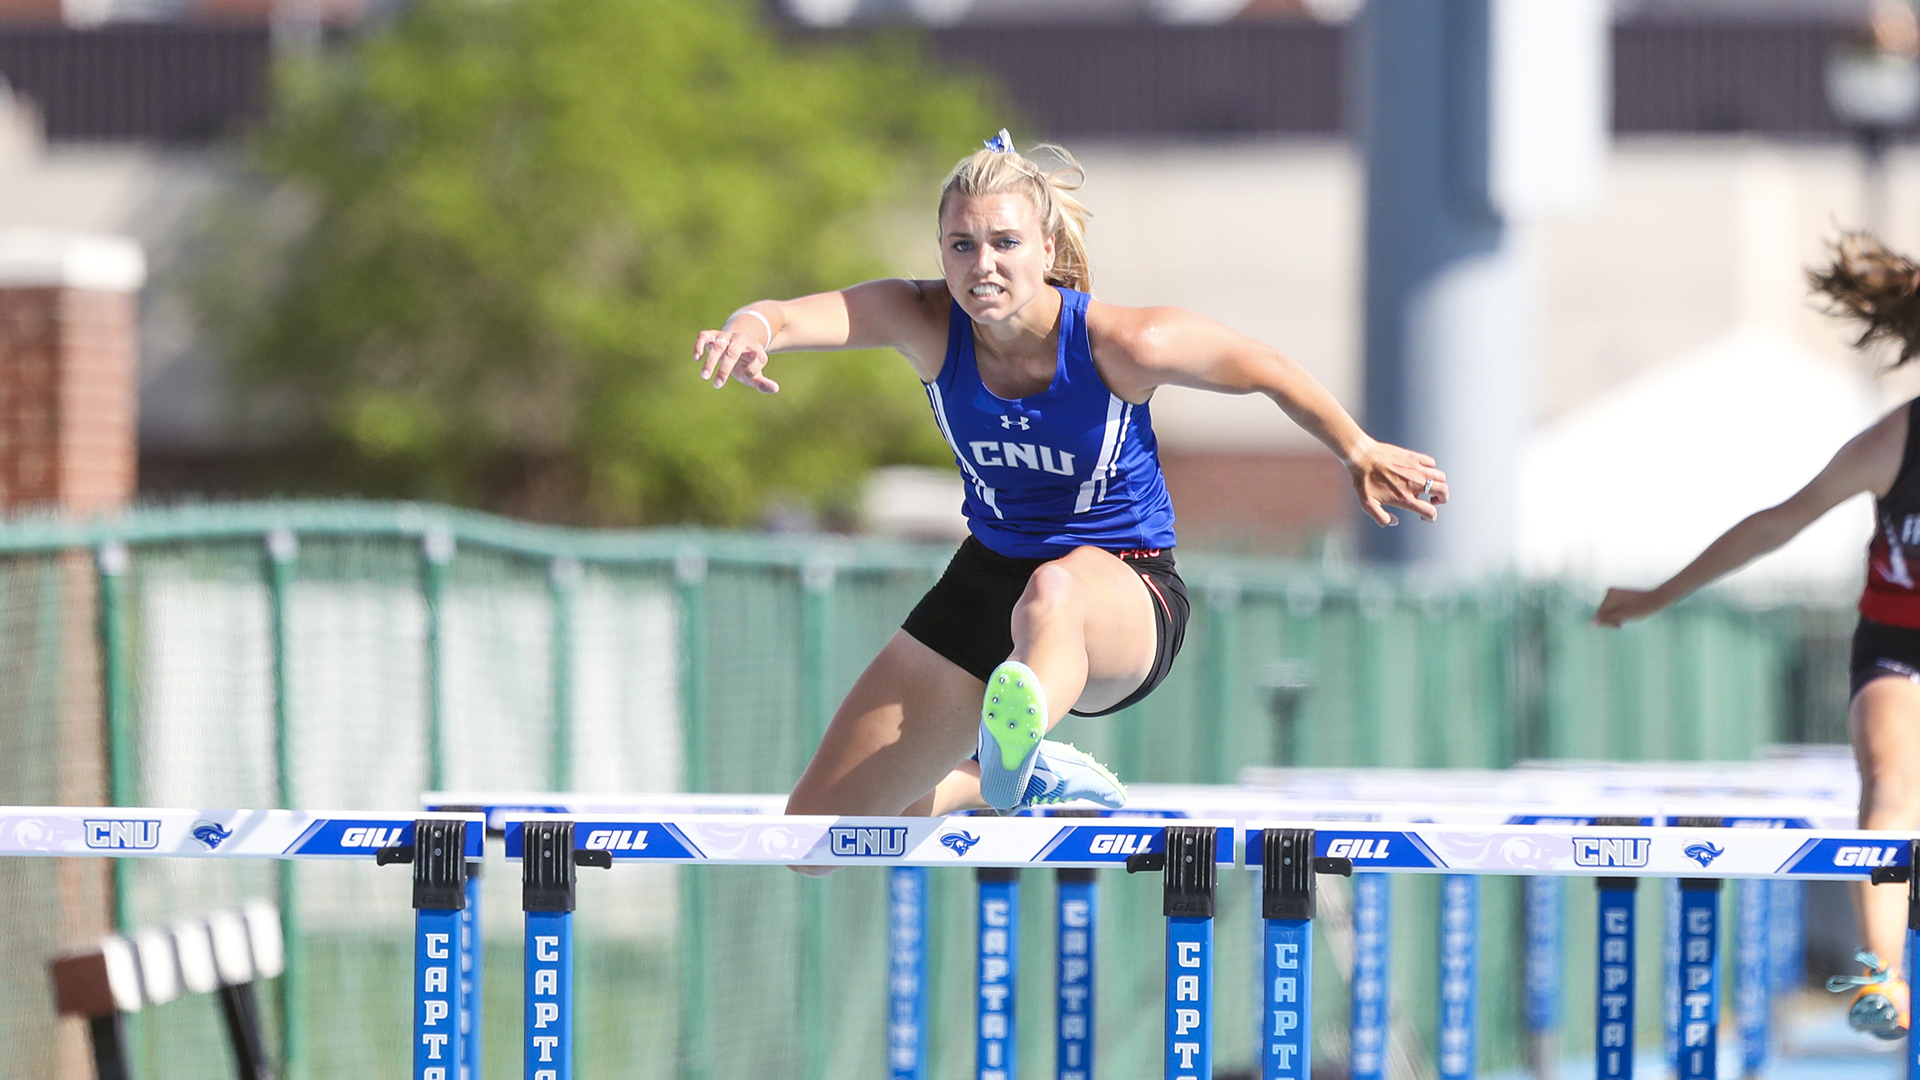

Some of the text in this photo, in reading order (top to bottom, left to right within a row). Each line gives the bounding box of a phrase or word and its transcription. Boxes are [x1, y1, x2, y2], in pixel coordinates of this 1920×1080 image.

[969, 441, 1076, 476] CNU
[84, 820, 161, 849] CNU
[340, 828, 403, 848] GILL
[585, 830, 649, 850] GILL
[830, 827, 908, 857] CNU
[1089, 834, 1154, 854] GILL
[1326, 839, 1390, 859] GILL
[1572, 838, 1651, 867] CNU
[1833, 846, 1898, 867] GILL
[1602, 907, 1628, 1080] CAPTAI
[1684, 907, 1712, 1080] CAPTAI
[1174, 942, 1200, 1080] CAPT
[1272, 943, 1298, 1080] CAPT
